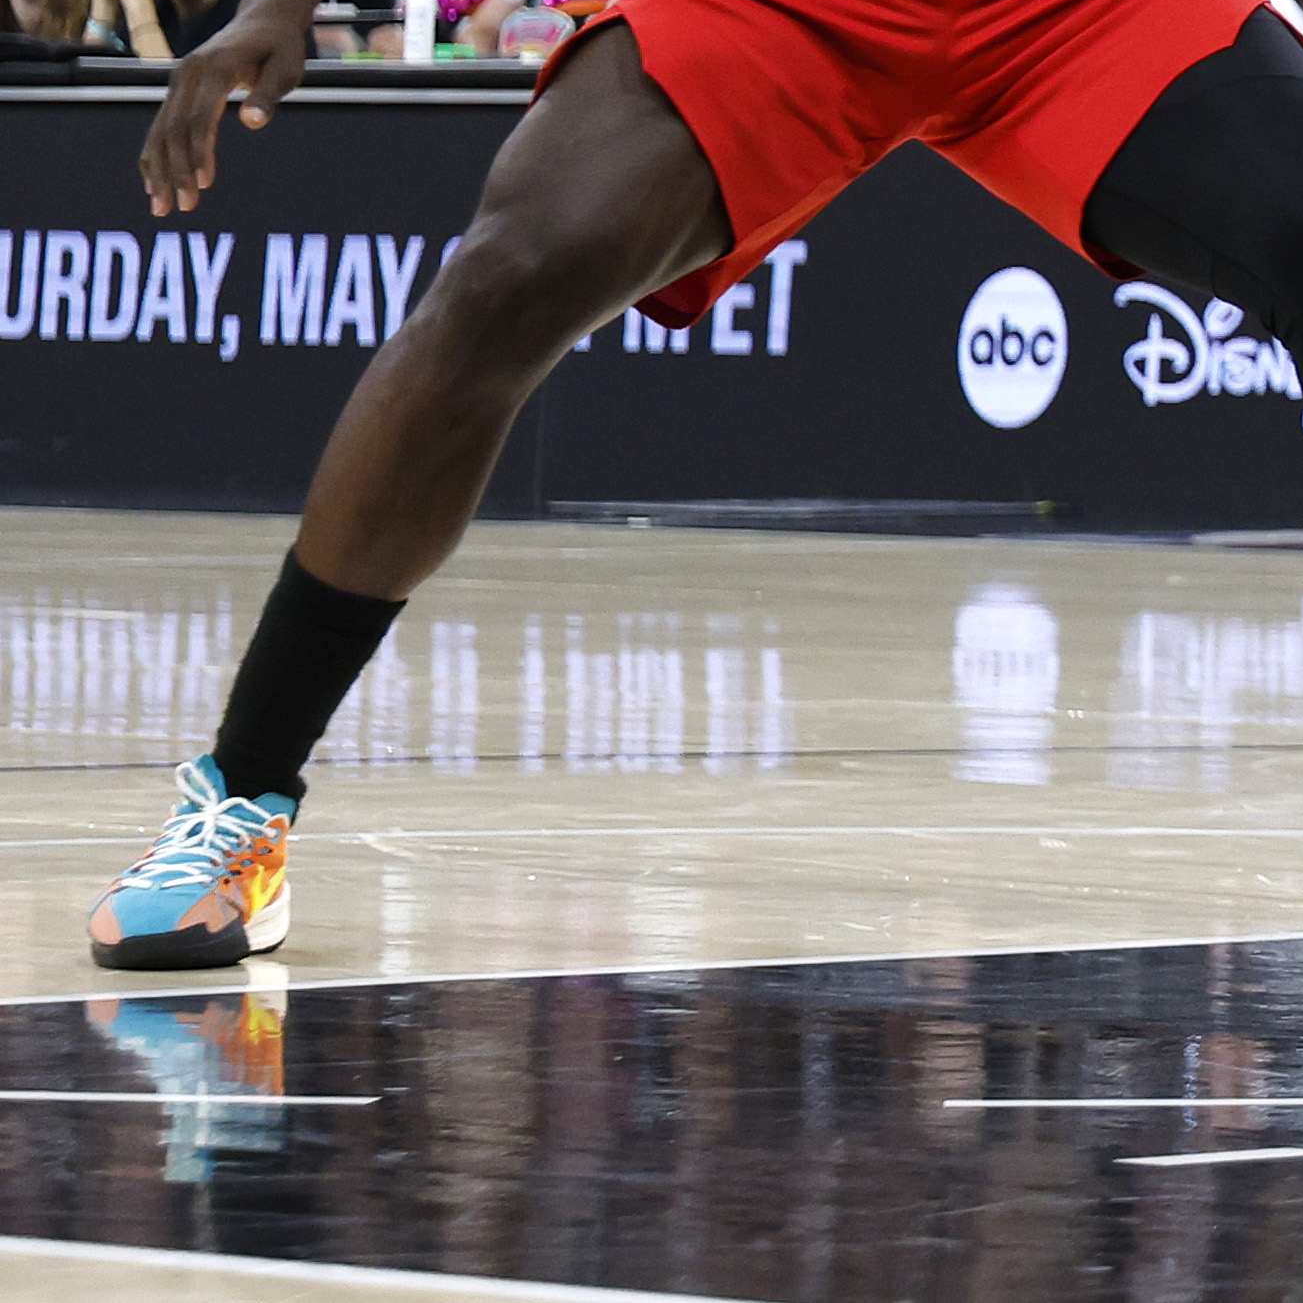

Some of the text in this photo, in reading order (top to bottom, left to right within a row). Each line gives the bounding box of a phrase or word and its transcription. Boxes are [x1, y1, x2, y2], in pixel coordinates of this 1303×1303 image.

[0, 228, 241, 362] URDAY,
[259, 233, 425, 347] MAY
[970, 313, 1055, 366] abc
